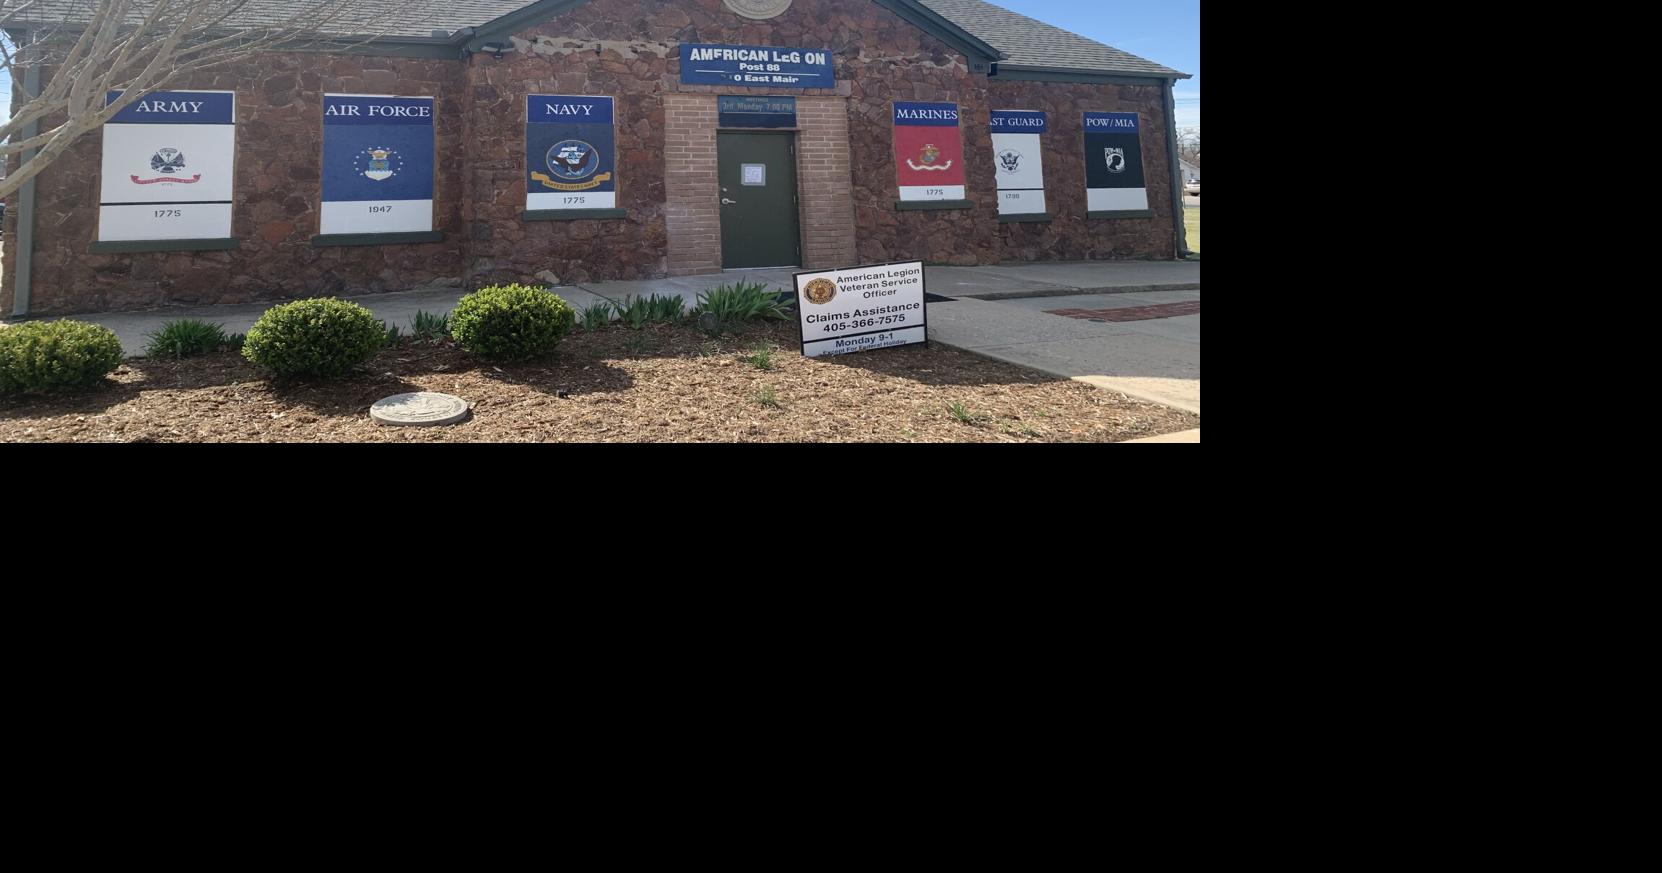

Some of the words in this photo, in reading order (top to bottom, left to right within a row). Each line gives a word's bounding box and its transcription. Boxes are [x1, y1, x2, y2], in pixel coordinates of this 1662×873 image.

[739, 62, 765, 71] Post
[767, 63, 781, 72] 88
[744, 74, 770, 82] East
[136, 100, 205, 113] ARMY
[325, 104, 361, 116] AIR
[368, 105, 430, 117] FORCE
[545, 104, 594, 116] NAVY
[896, 109, 958, 120] MARINES
[1007, 117, 1044, 126] GUARD
[154, 210, 181, 218] 1775
[368, 205, 392, 213] 1947
[836, 273, 885, 284] American
[887, 268, 920, 279] Legion
[840, 283, 879, 293] Veteran
[881, 277, 918, 288] Service
[863, 289, 897, 299] Officer
[806, 311, 850, 324] Claims
[853, 302, 920, 318] Assistance
[823, 313, 906, 333] 405-366-7575
[835, 336, 876, 348] Monday
[878, 333, 894, 341] 9-1
